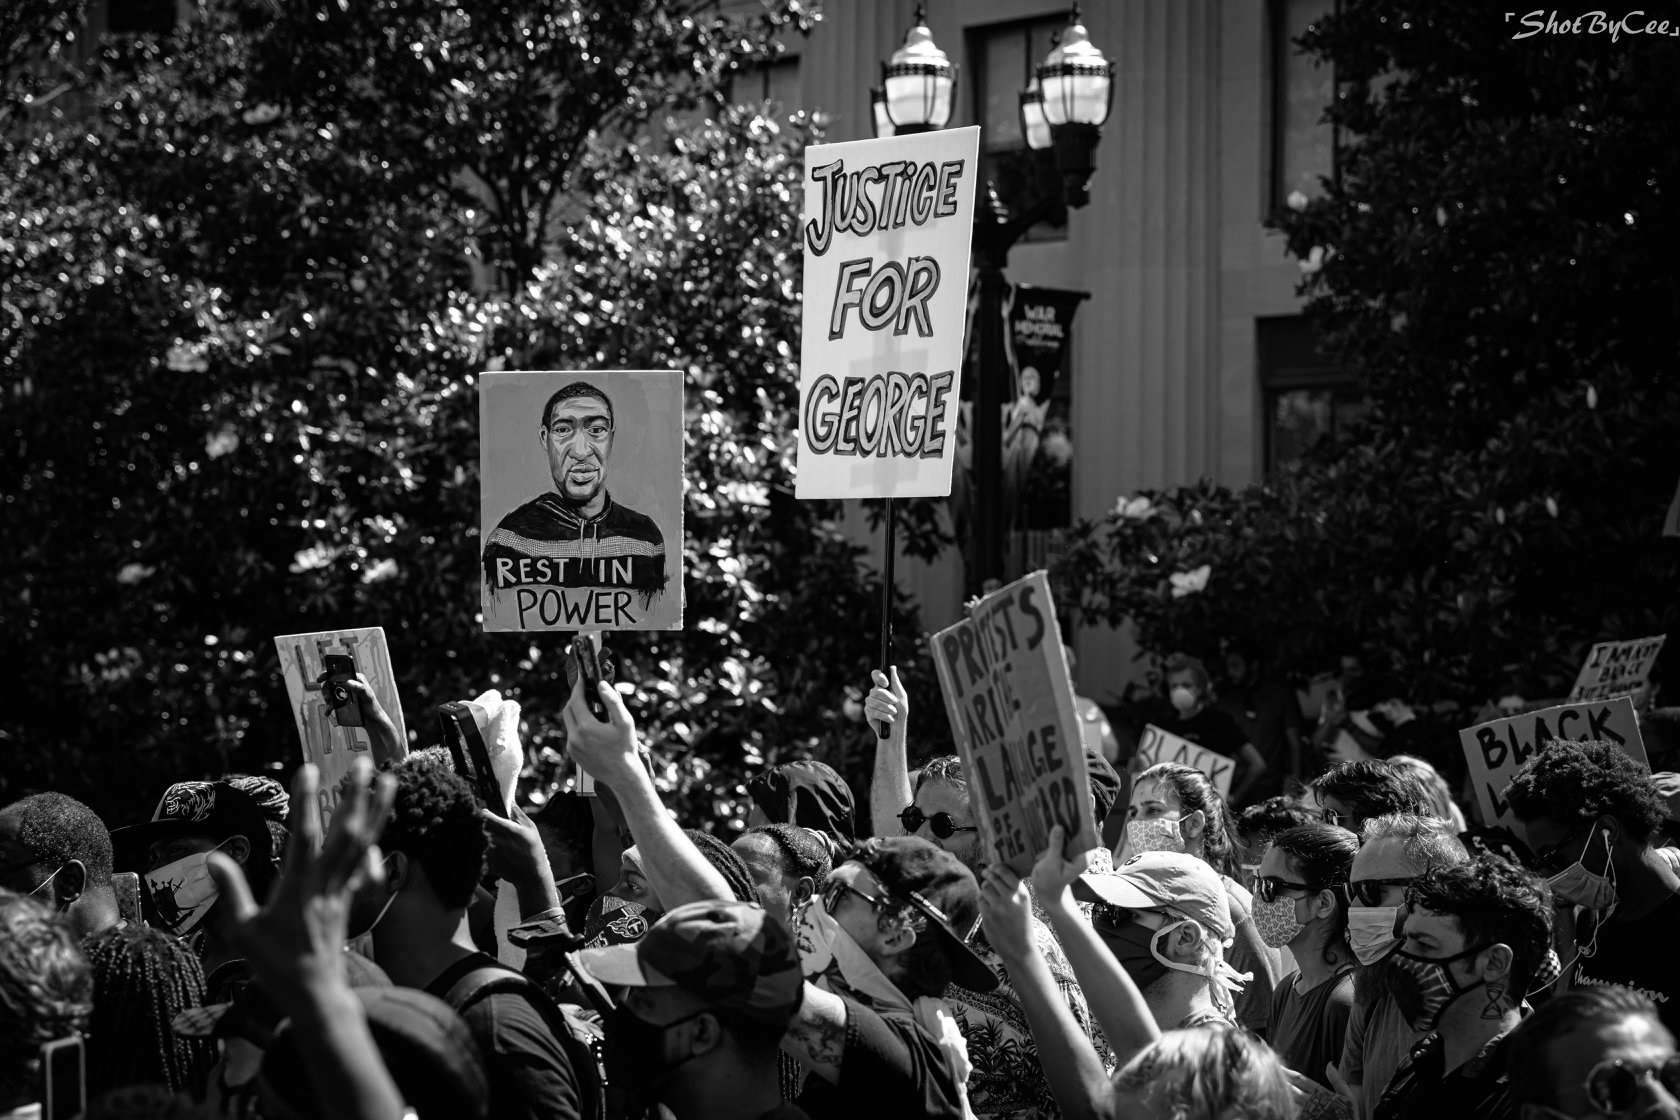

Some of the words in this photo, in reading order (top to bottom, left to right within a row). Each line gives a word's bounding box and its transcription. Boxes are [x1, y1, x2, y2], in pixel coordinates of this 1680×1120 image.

[828, 256, 942, 341] FOR
[804, 370, 954, 459] GEORGE
[496, 557, 570, 588] REST
[600, 556, 633, 584] IN
[516, 588, 637, 629] POWER
[993, 812, 1013, 835] OF
[994, 828, 1026, 862] THE
